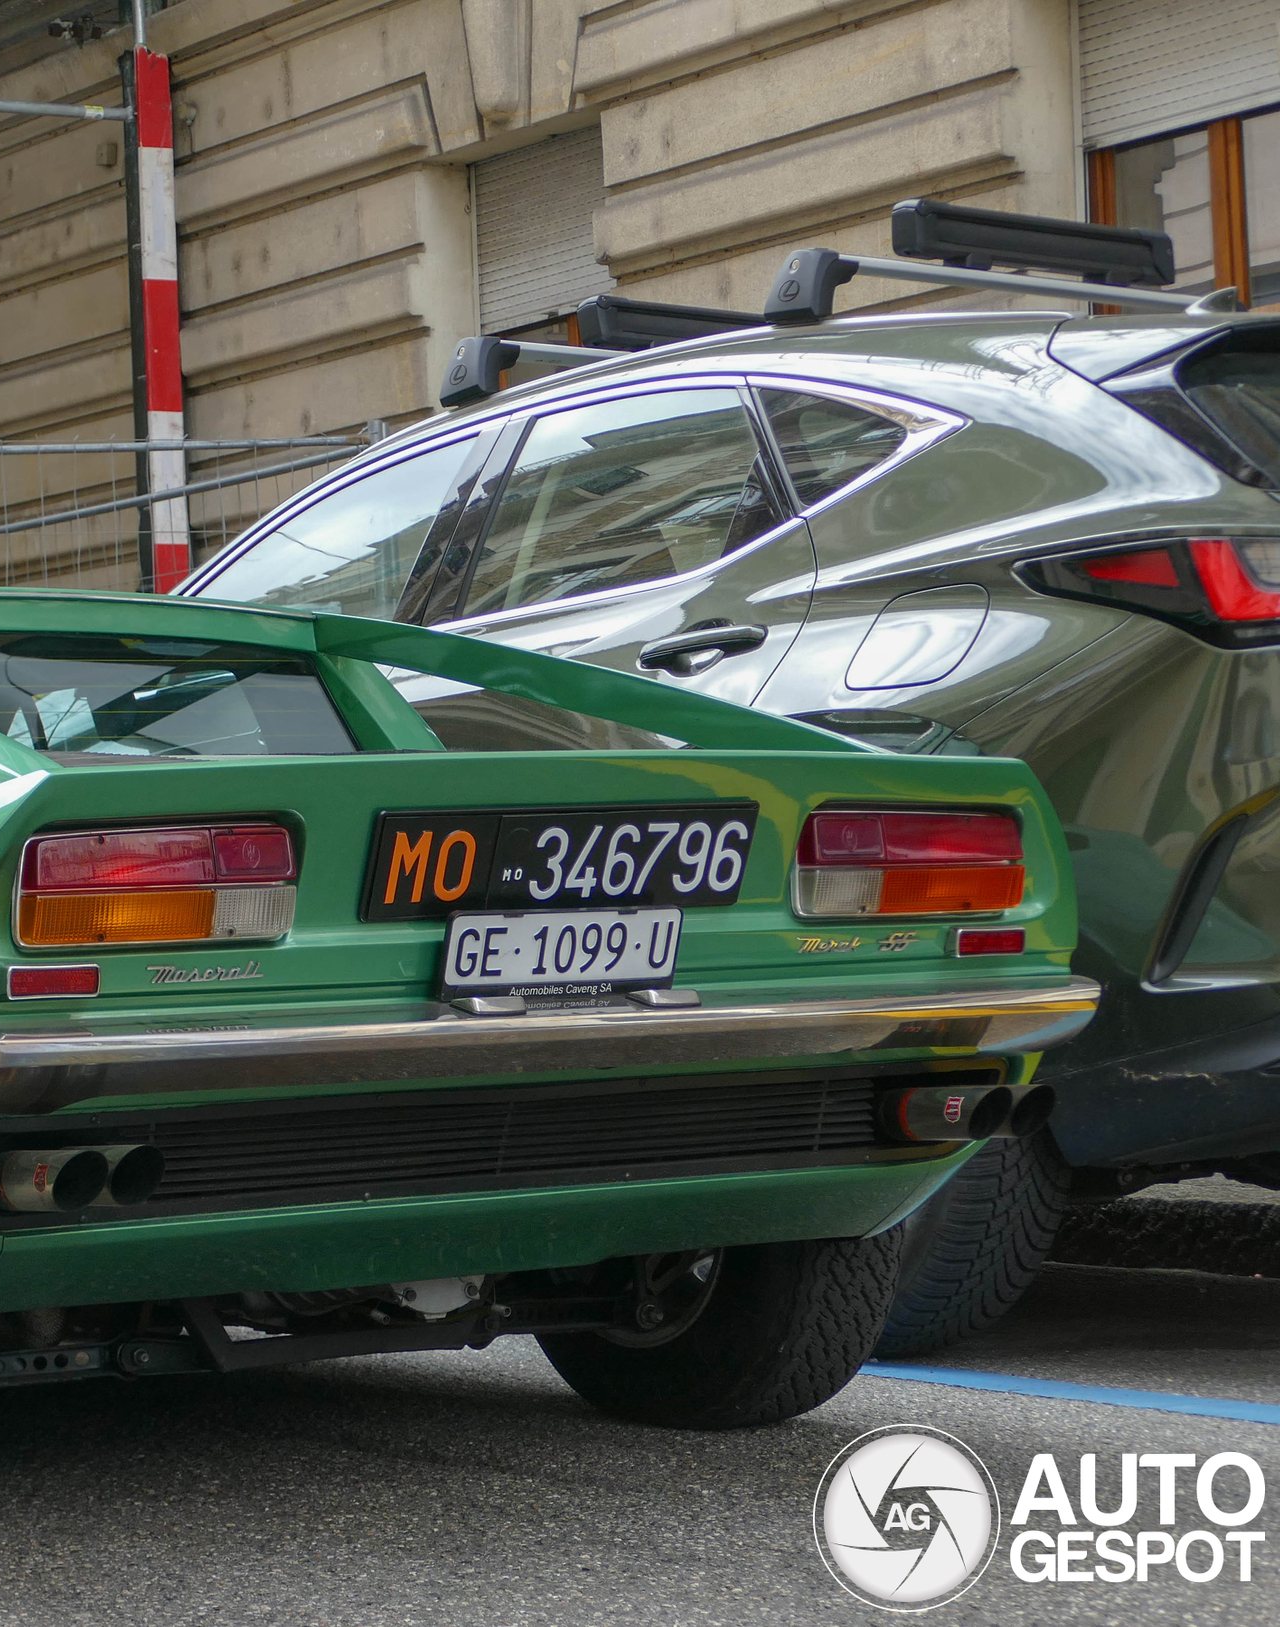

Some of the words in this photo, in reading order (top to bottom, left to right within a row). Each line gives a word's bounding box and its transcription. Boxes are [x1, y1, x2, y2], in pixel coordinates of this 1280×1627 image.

[383, 829, 477, 904] MO
[502, 868, 523, 882] MO
[529, 820, 749, 900] 346796
[146, 960, 263, 984] Maserati
[509, 985, 563, 996] Automobiles
[566, 984, 598, 995] Caveng
[600, 983, 612, 993] SA
